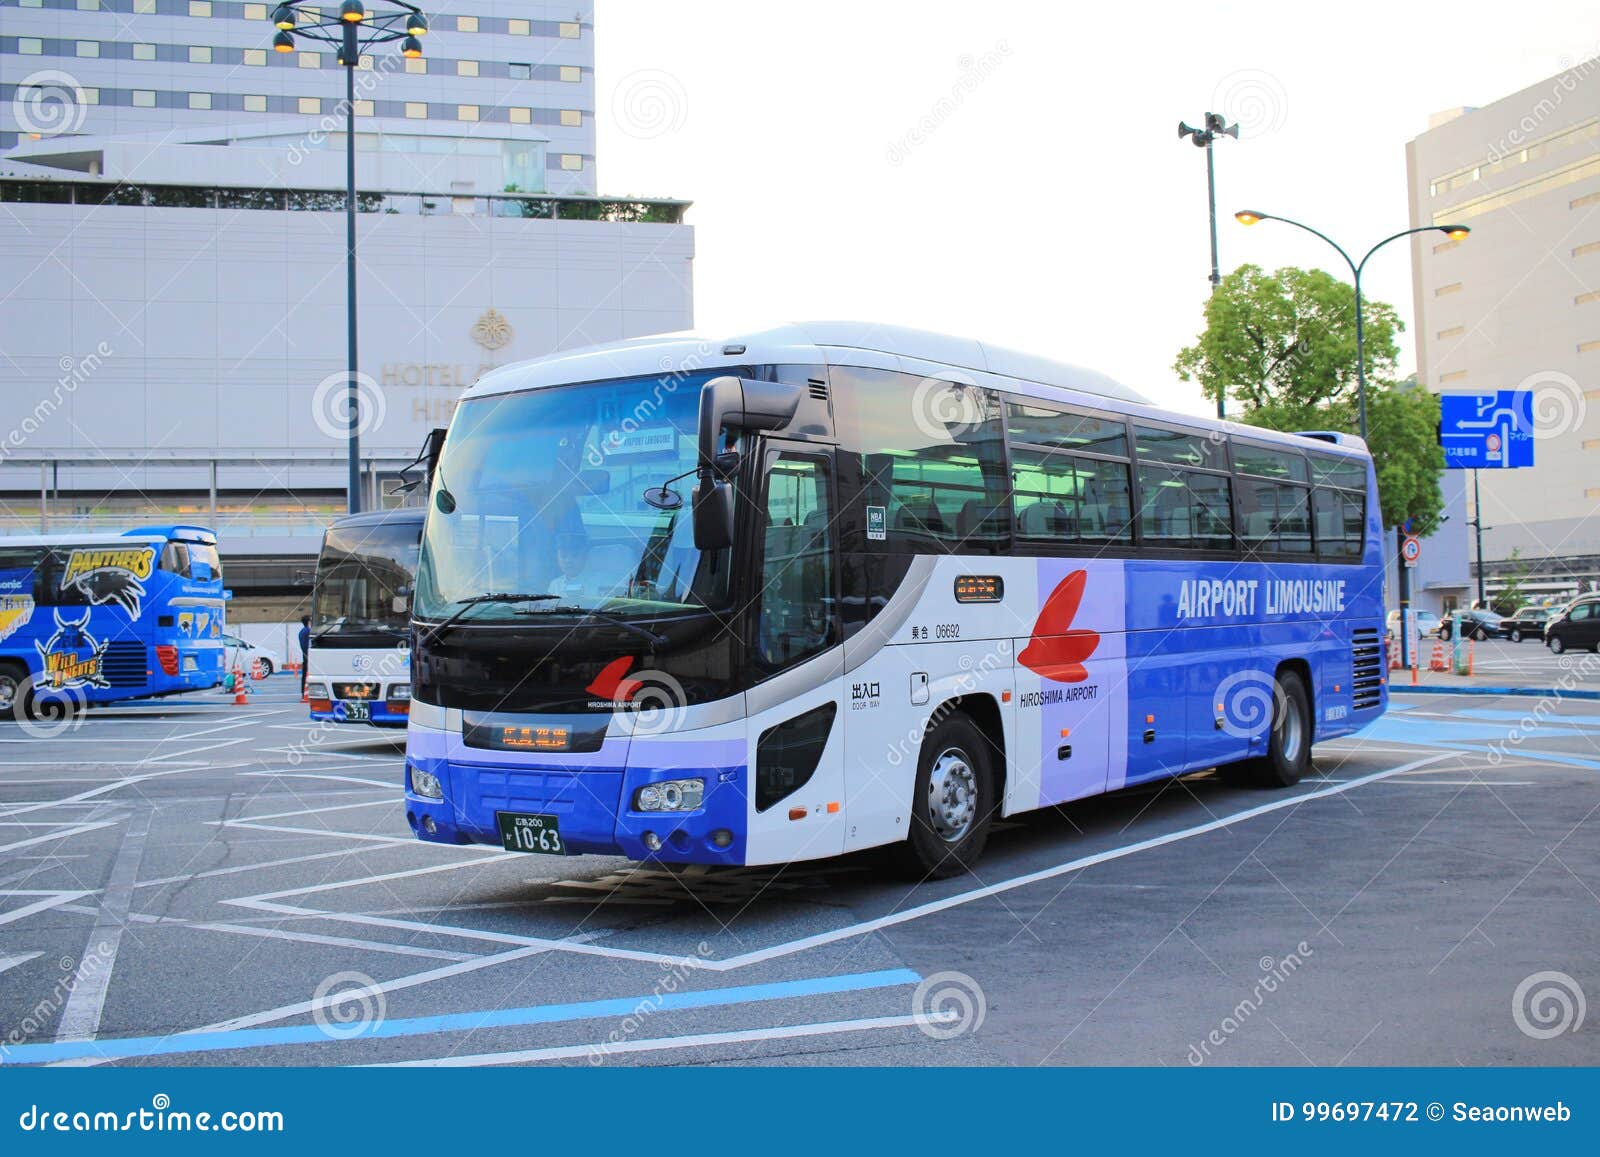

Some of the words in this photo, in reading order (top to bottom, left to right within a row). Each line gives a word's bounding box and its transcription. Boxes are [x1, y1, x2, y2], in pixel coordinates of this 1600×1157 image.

[381, 364, 467, 387] HOTEL
[1176, 580, 1259, 618] AIRPORT
[1265, 580, 1346, 615] LIMOUSINE
[911, 626, 928, 640] 乗合
[935, 624, 960, 639] 06692
[852, 682, 880, 699] 出入口
[1020, 690, 1063, 708] HIROSHIMA
[1065, 685, 1098, 703] AIRPORT
[514, 826, 561, 851] 10-63
